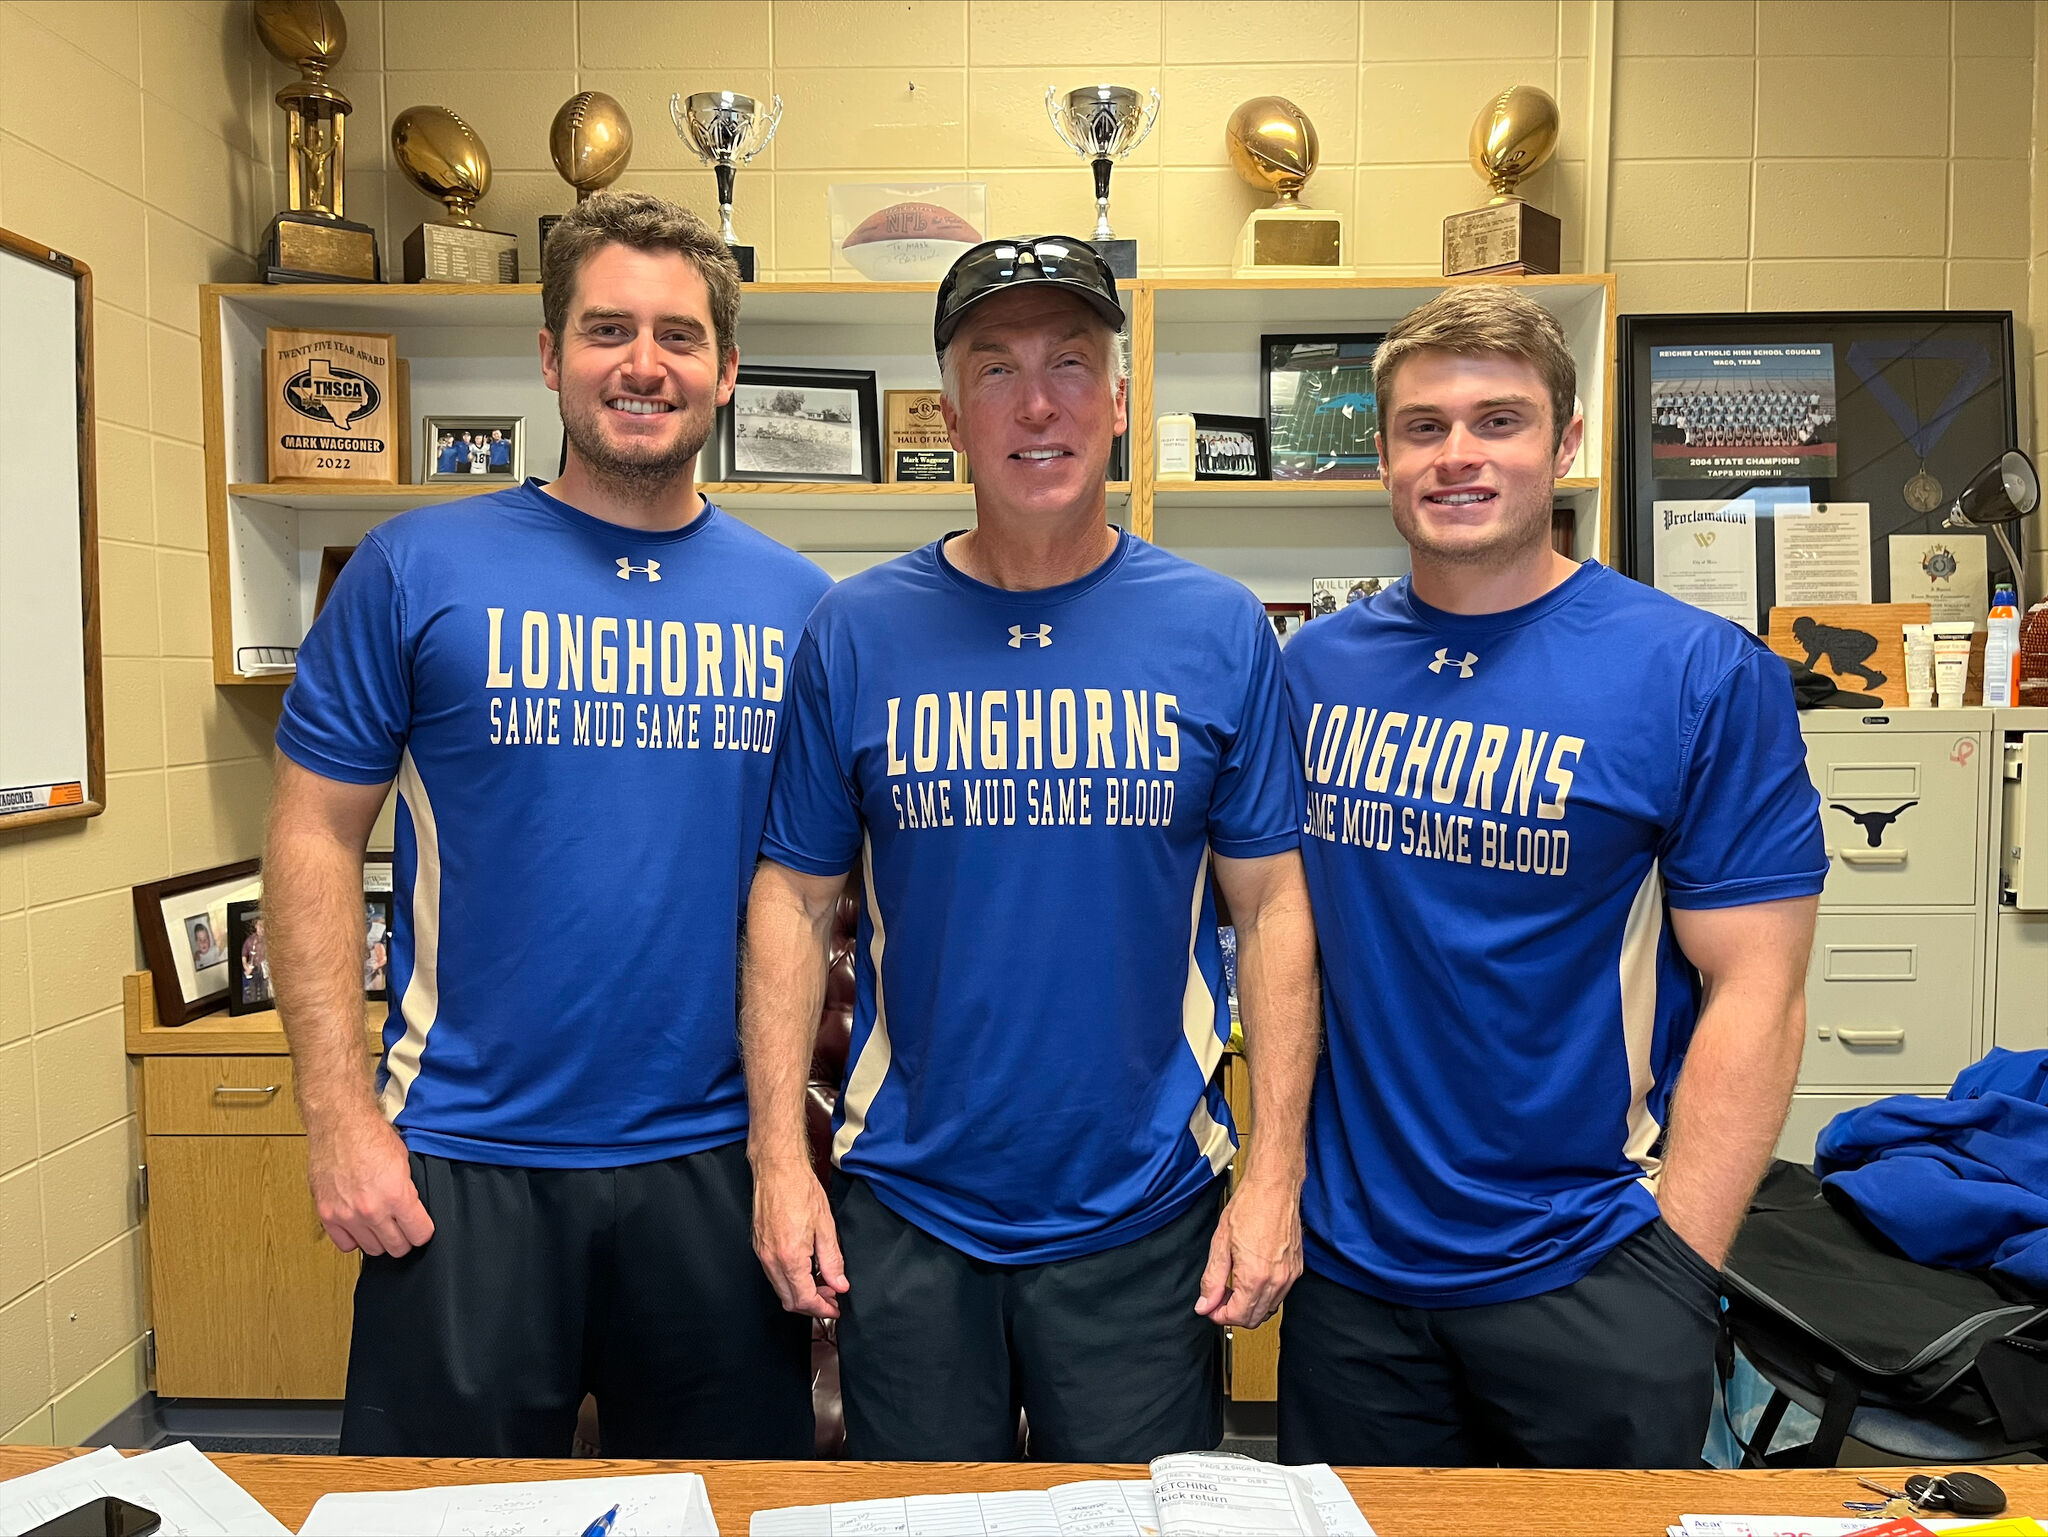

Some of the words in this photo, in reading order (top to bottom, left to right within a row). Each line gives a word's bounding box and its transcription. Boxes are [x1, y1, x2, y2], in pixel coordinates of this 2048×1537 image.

[278, 345, 312, 360] TWENTY
[314, 340, 333, 352] FIVE
[333, 341, 355, 354] YEAR
[356, 351, 386, 366] AWARD
[314, 380, 362, 397] THSCA
[285, 436, 318, 449] MARK
[320, 438, 381, 452] WAGGONER
[317, 458, 351, 469] 2022
[920, 456, 949, 464] Waggoner
[1714, 458, 1744, 466] STATE
[1663, 510, 1747, 530] Proclamation
[1315, 579, 1355, 589] WILLIE
[485, 607, 785, 703] LONGHORNS
[490, 696, 561, 745] SAME
[573, 699, 625, 748] MUD
[636, 703, 701, 749] SAME
[713, 703, 776, 754] BLOOD
[886, 688, 1180, 777] LONGHORNS
[1304, 702, 1585, 821] LONGHORNS
[0, 791, 34, 806] AGGONER
[892, 779, 954, 830] SAME
[963, 778, 1017, 827] MUD
[1027, 777, 1092, 826] SAME
[1105, 777, 1175, 827] BLOOD
[1303, 789, 1337, 843] SAME
[1342, 796, 1394, 852] MUD
[1400, 806, 1474, 865] SAME
[1481, 820, 1570, 877] BLOOD
[1190, 1493, 1228, 1503] return
